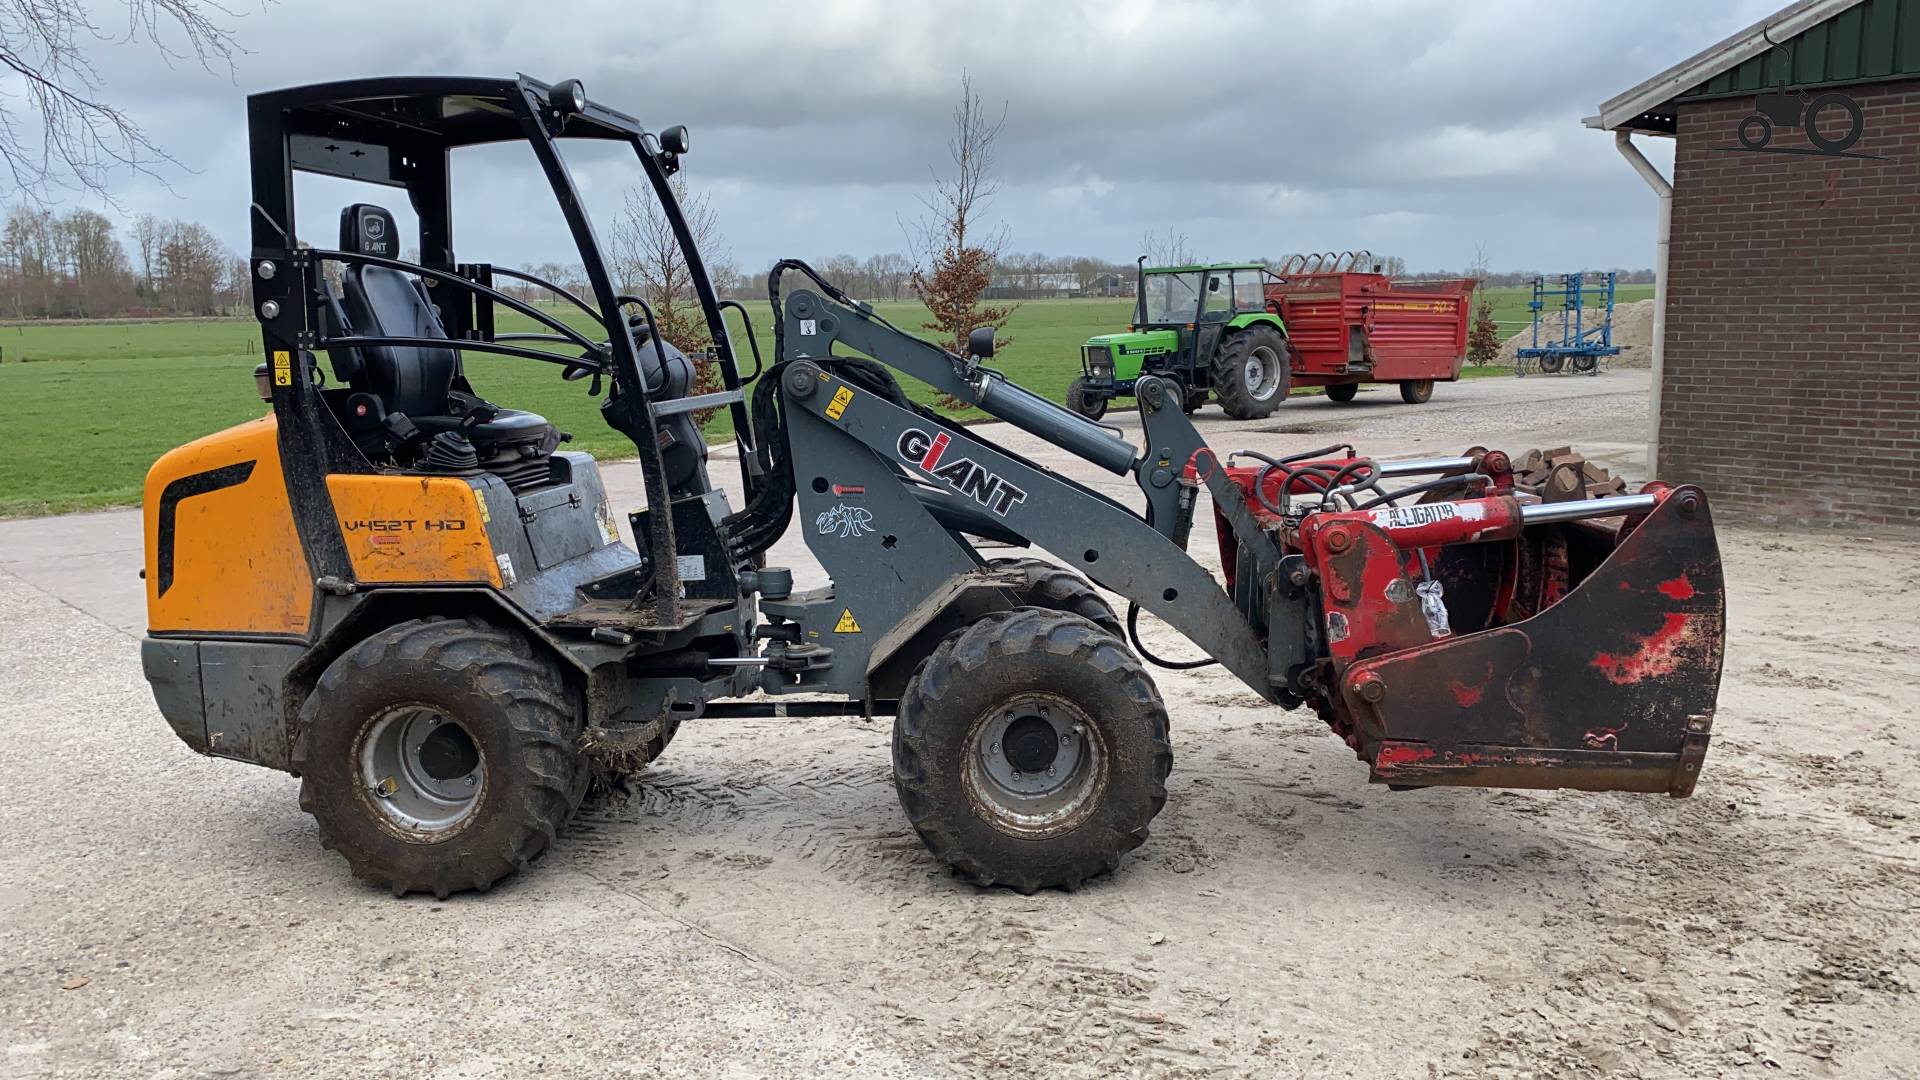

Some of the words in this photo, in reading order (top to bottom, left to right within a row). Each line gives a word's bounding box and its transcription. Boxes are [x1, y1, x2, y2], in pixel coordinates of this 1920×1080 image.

[364, 241, 387, 251] GANT
[1388, 503, 1455, 528] ALLIGATOR
[344, 520, 417, 532] V452T
[424, 519, 465, 531] HD
